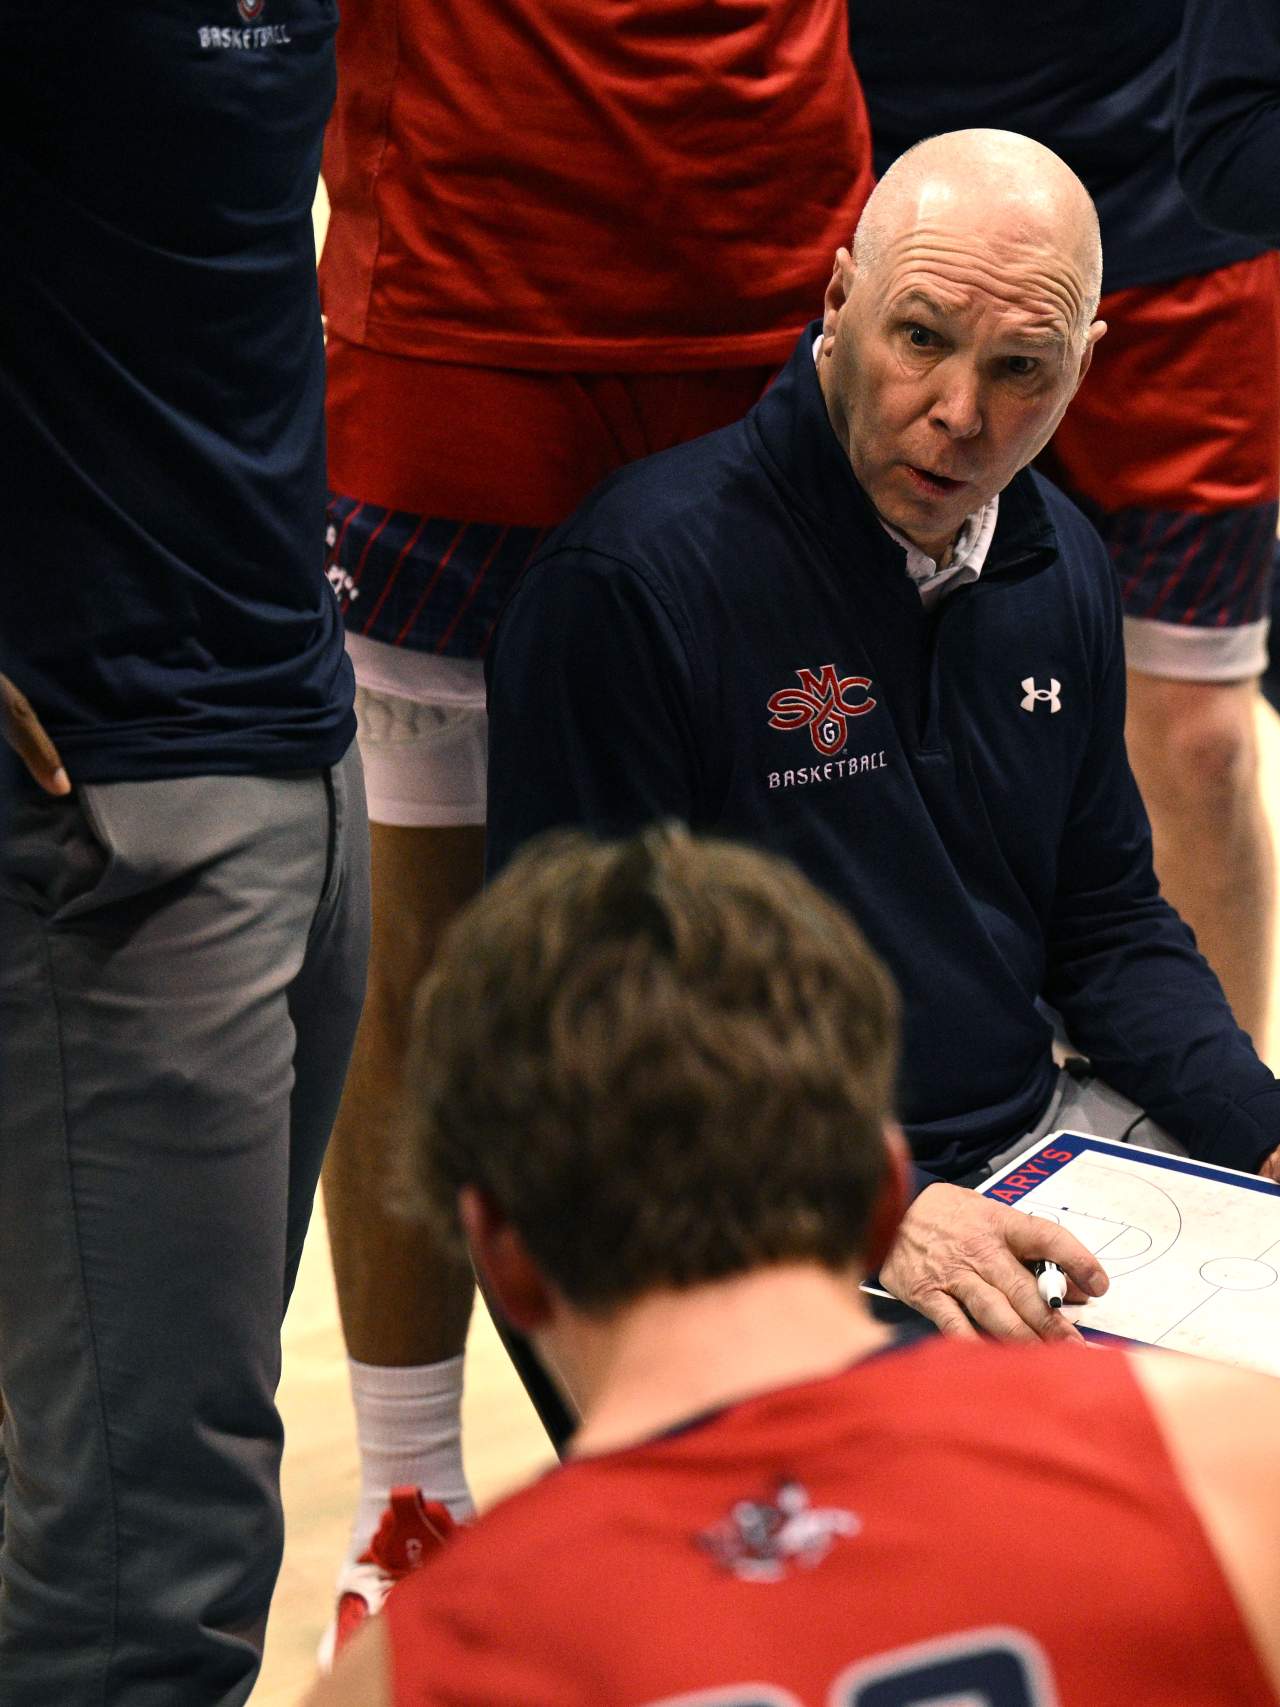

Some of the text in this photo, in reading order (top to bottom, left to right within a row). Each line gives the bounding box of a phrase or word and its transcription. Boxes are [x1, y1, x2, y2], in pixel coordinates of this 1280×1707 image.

[198, 25, 291, 48] BASKETBALL
[768, 750, 887, 788] BASKETBALL
[991, 1148, 1074, 1204] ARY'S
